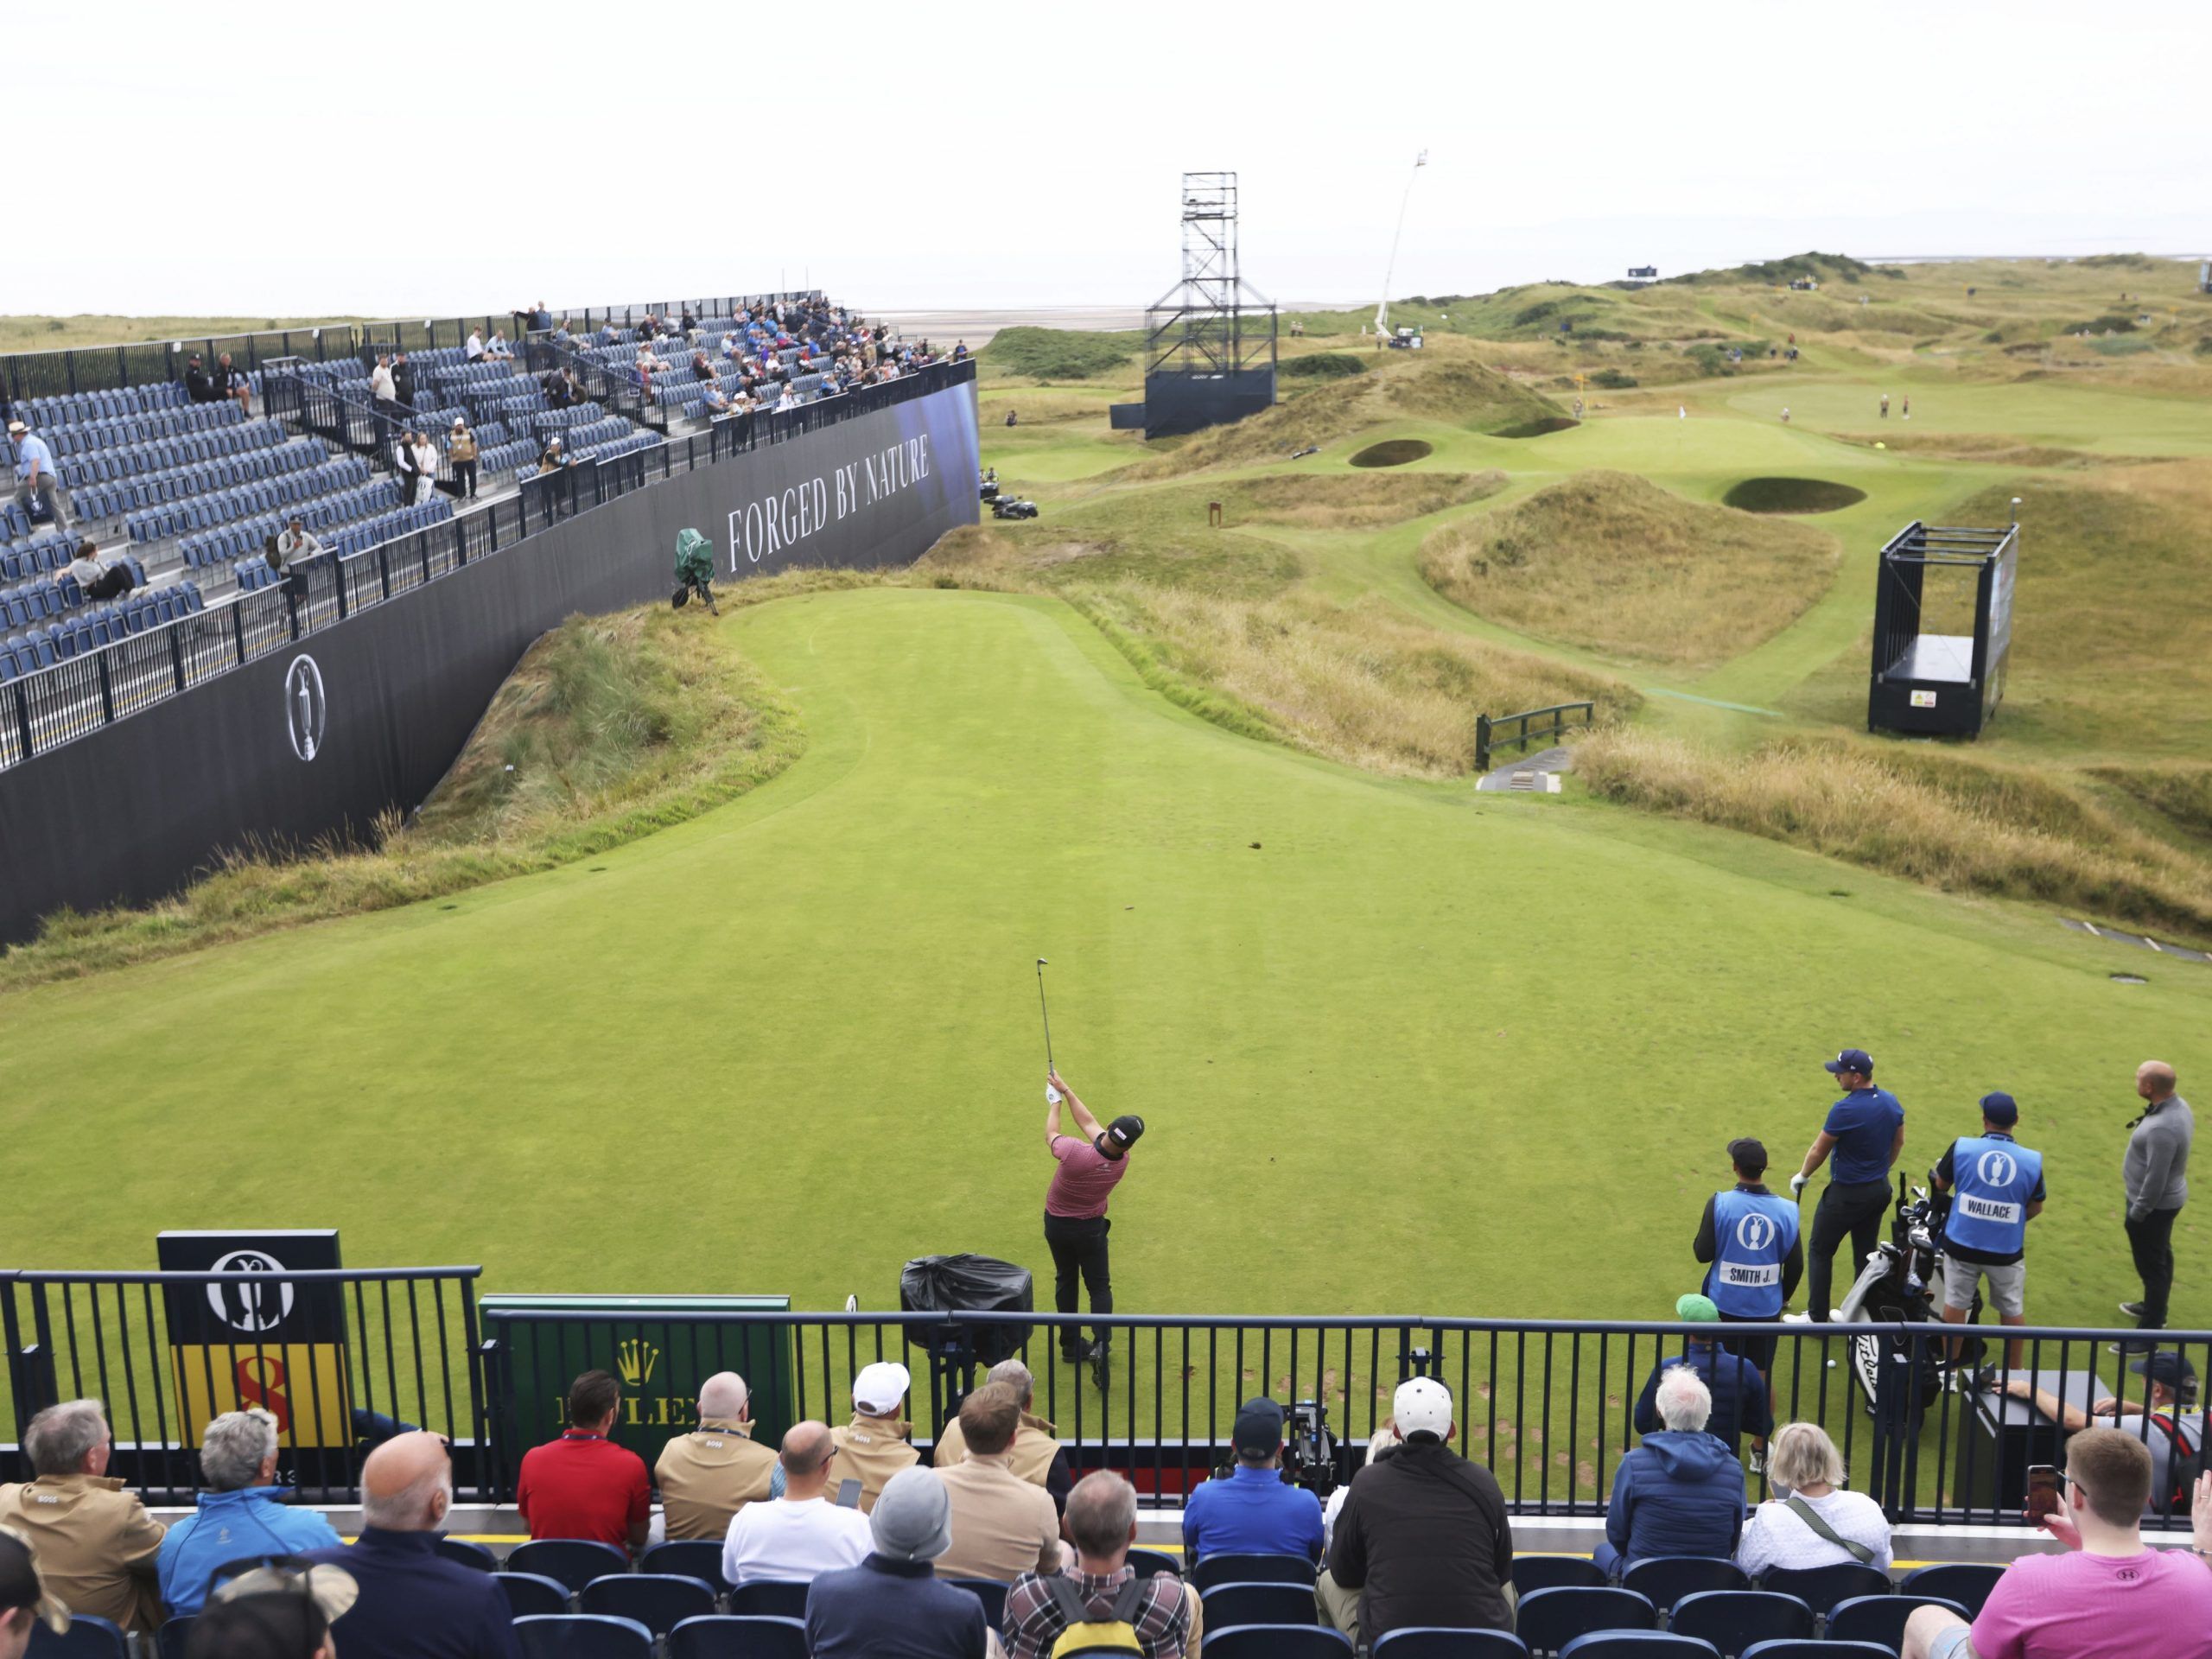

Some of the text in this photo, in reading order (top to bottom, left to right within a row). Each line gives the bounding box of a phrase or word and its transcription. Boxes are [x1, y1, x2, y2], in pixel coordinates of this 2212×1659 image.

[728, 434, 929, 573] FORGED BY NATURE
[1967, 1199, 2012, 1219] WALLACE
[1730, 1268, 1770, 1283] SMITH J.
[1856, 1334, 1876, 1388] Titlei
[235, 1356, 290, 1435] 8
